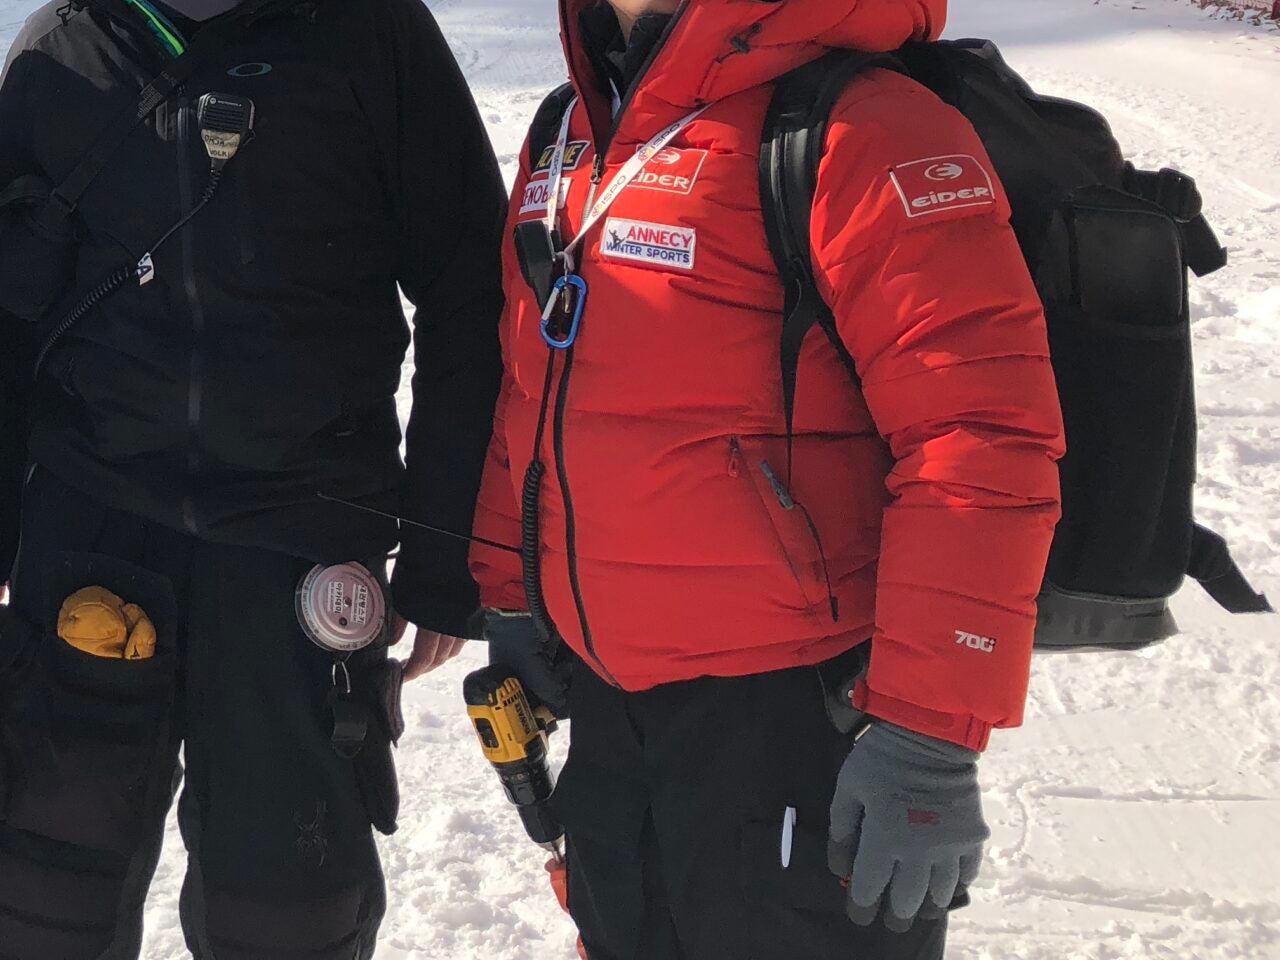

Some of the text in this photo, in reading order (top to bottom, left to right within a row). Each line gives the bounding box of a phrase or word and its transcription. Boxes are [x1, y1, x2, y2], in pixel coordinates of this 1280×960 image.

[651, 123, 681, 150] ISPO
[601, 175, 627, 205] ISPO
[626, 225, 693, 249] ANNECY
[606, 241, 690, 264] WINTER SPORTS
